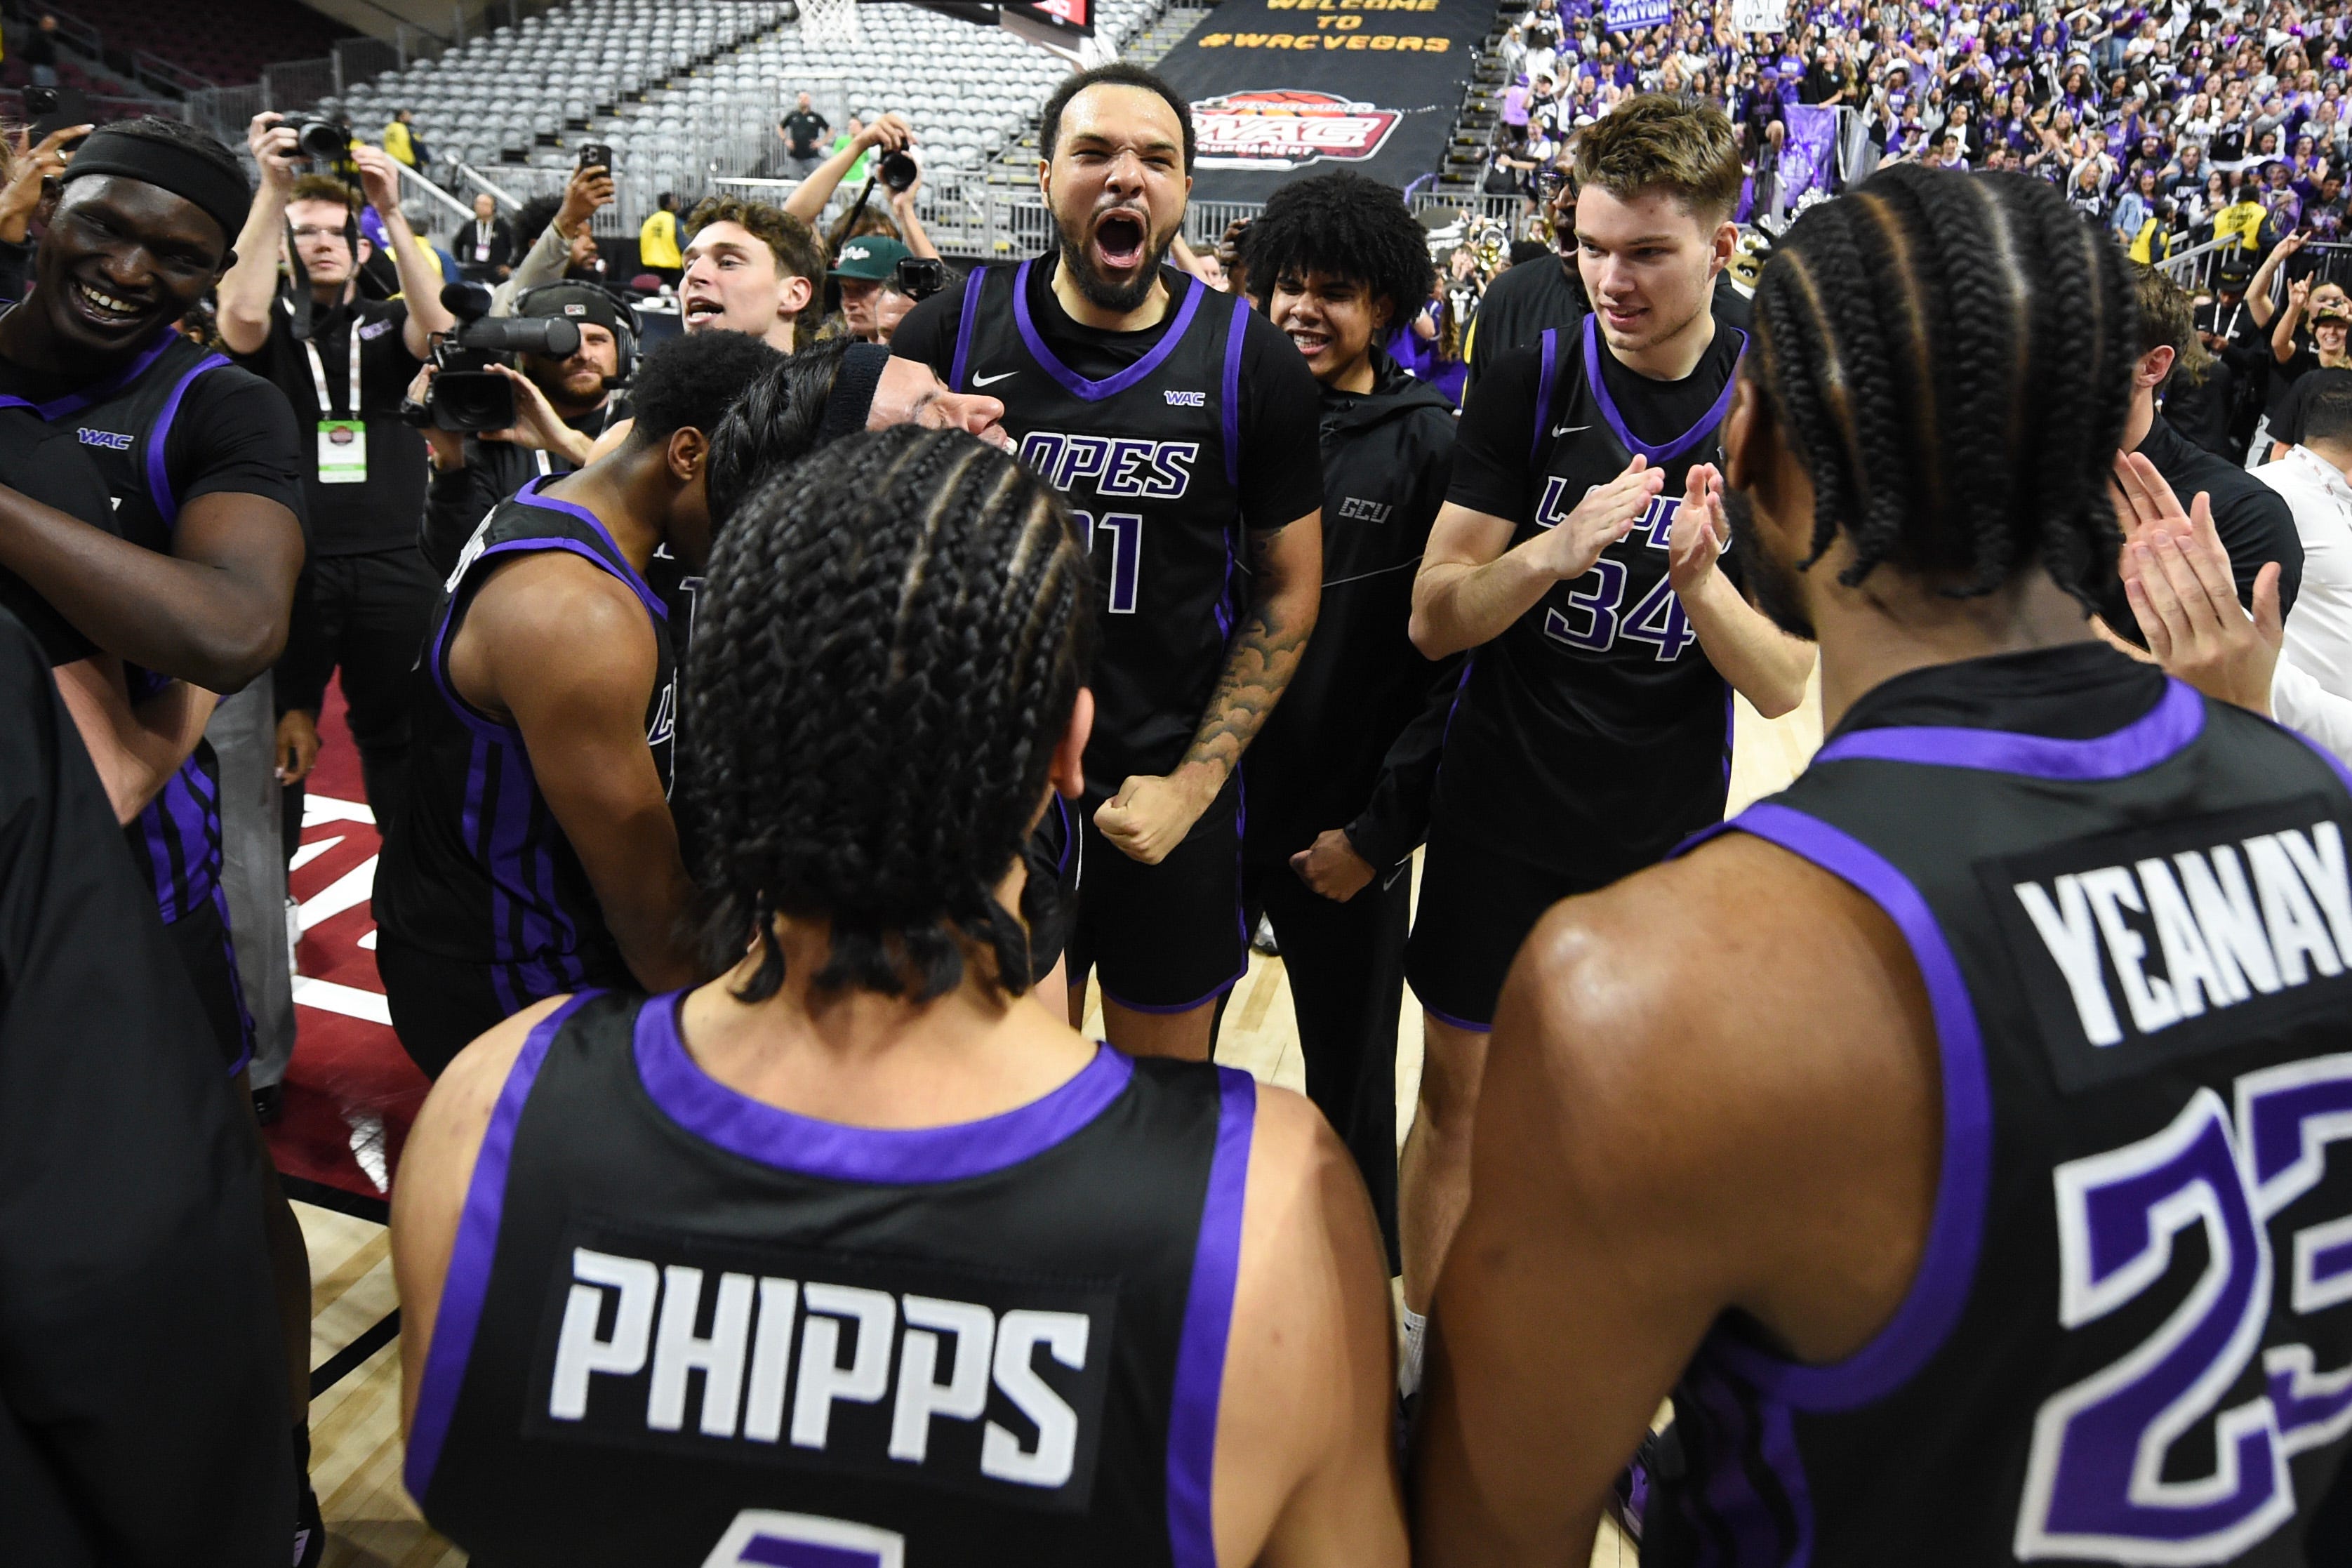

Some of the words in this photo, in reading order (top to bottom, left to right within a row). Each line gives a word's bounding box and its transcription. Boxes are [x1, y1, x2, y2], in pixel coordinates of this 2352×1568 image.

[1266, 0, 1439, 11] WELCOME
[1606, 0, 1668, 25] CANYON
[1317, 15, 1362, 29] TO
[1198, 34, 1450, 52] #WACVEGAS
[1192, 113, 1381, 147] WAC
[1196, 143, 1315, 155] OURNAMENT
[1164, 390, 1205, 406] WAC
[77, 427, 135, 450] WAC
[1018, 431, 1200, 499] OPES
[1338, 496, 1393, 524] GCU
[1065, 509, 1143, 614] 1
[1544, 558, 1696, 662] 34
[2013, 820, 2352, 1047] YEANAY
[550, 1247, 1089, 1488] PHIPPS
